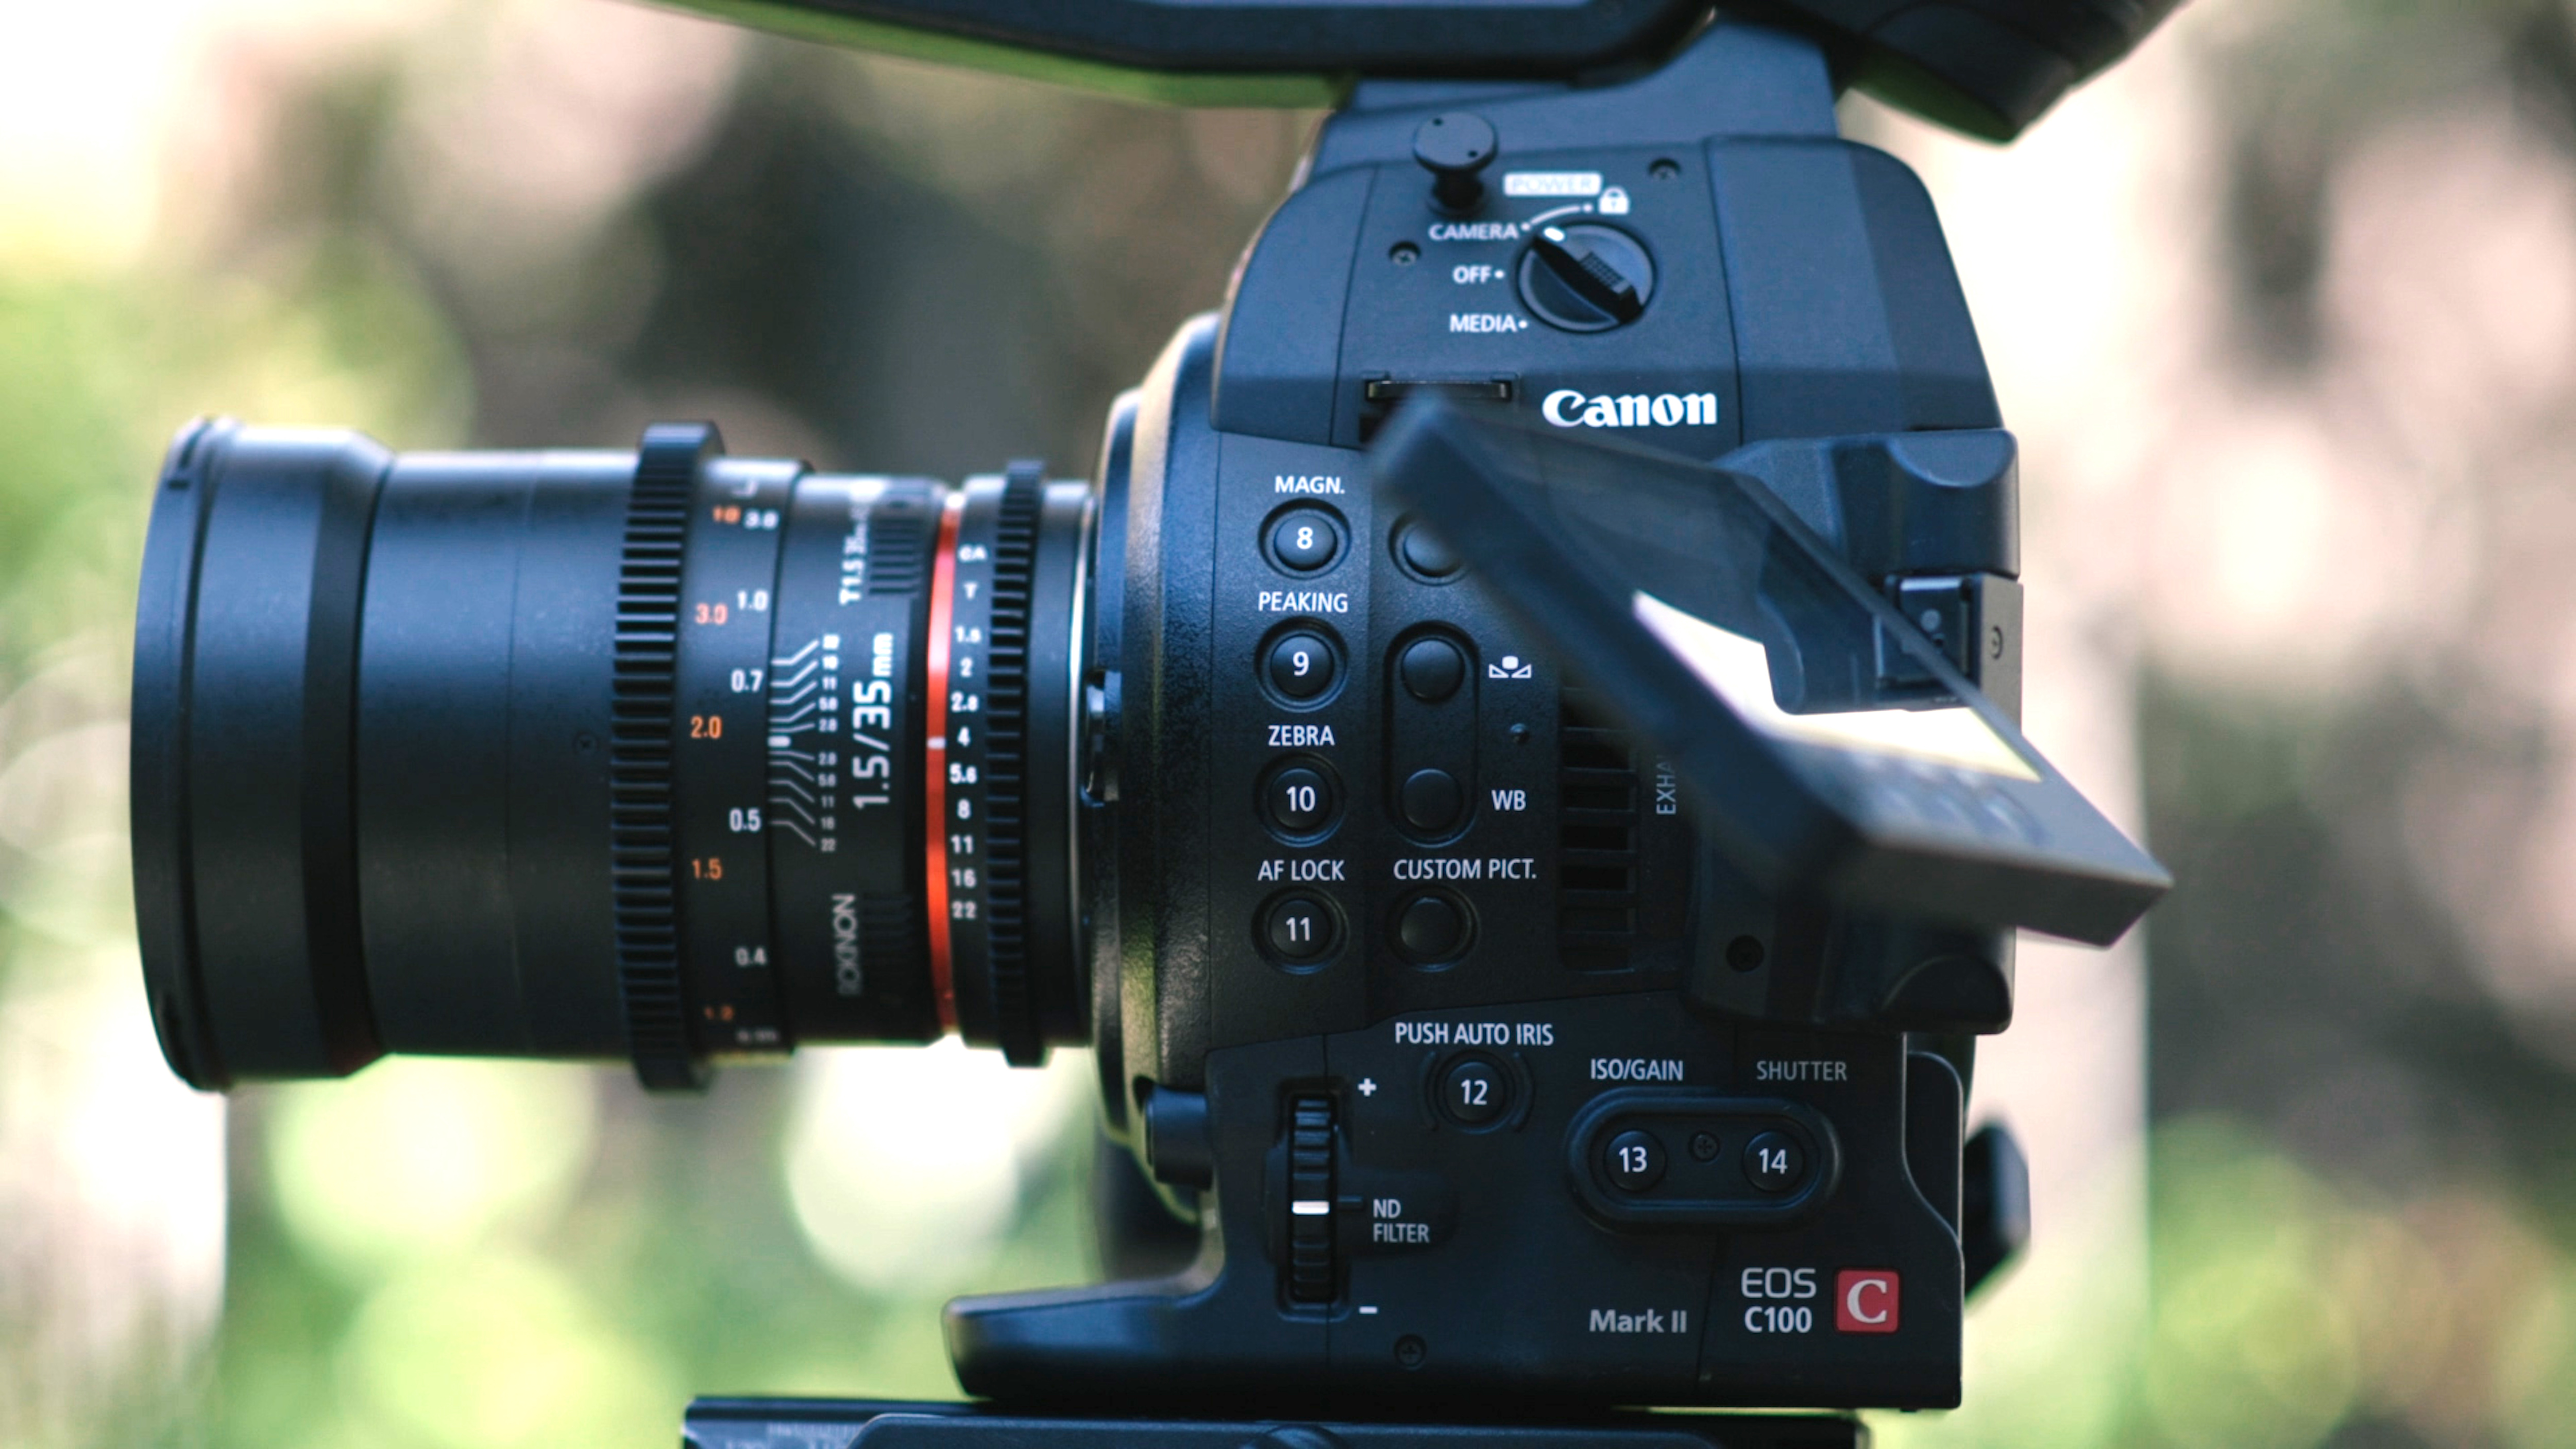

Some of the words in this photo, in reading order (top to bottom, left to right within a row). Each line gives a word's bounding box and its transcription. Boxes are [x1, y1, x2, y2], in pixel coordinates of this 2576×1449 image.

[1513, 177, 1592, 194] POWER
[1429, 223, 1518, 241] CAMERA
[1453, 266, 1490, 283] OFF
[1450, 315, 1517, 333] MEDIA
[1543, 389, 1717, 427] Canon
[1275, 476, 1345, 493] MAGN.
[1297, 527, 1313, 550] 8
[737, 590, 769, 611] 1.0
[964, 582, 978, 600] T
[1258, 591, 1348, 612] PEAKING
[695, 602, 728, 625] 3.0
[960, 658, 973, 677] 2
[1293, 651, 1310, 676] 9
[731, 669, 763, 692] 0.7
[822, 676, 837, 690] 11
[951, 691, 978, 712] 2.8
[691, 715, 722, 739] 2.0
[957, 726, 971, 746] 4
[1268, 725, 1335, 747] ZEBRA
[950, 763, 977, 784] 5.6
[1655, 755, 1677, 815] EXHA
[957, 798, 971, 820] 8
[1286, 786, 1316, 812] 10
[1491, 790, 1526, 811] WB
[729, 808, 761, 831] 0.5
[951, 835, 974, 854] 11
[692, 858, 722, 879] 1.5
[952, 868, 976, 888] 16
[1258, 860, 1284, 881] AF
[1291, 860, 1345, 881] LOCK
[1394, 859, 1481, 880] CUSTOM
[1488, 859, 1536, 880] PICT.
[952, 901, 976, 919] 22
[1286, 917, 1310, 941] 11
[734, 946, 767, 966] 0.4
[1395, 1022, 1449, 1044] PUSH
[1454, 1023, 1510, 1045] AUTO
[1516, 1024, 1554, 1046] IRIS
[1590, 1059, 1684, 1081] ISO/GAIN
[1756, 1061, 1848, 1081] SHUTTER
[1461, 1080, 1488, 1105] 12
[1619, 1147, 1647, 1173] 13
[1758, 1149, 1787, 1174] 14
[1373, 1199, 1401, 1218] ND
[1373, 1224, 1430, 1243] FILTER
[1741, 1268, 1816, 1298] EOS
[1847, 1280, 1887, 1324] C
[1589, 1309, 1664, 1333] Mark
[1671, 1310, 1687, 1333] II
[1744, 1307, 1812, 1333] C100
